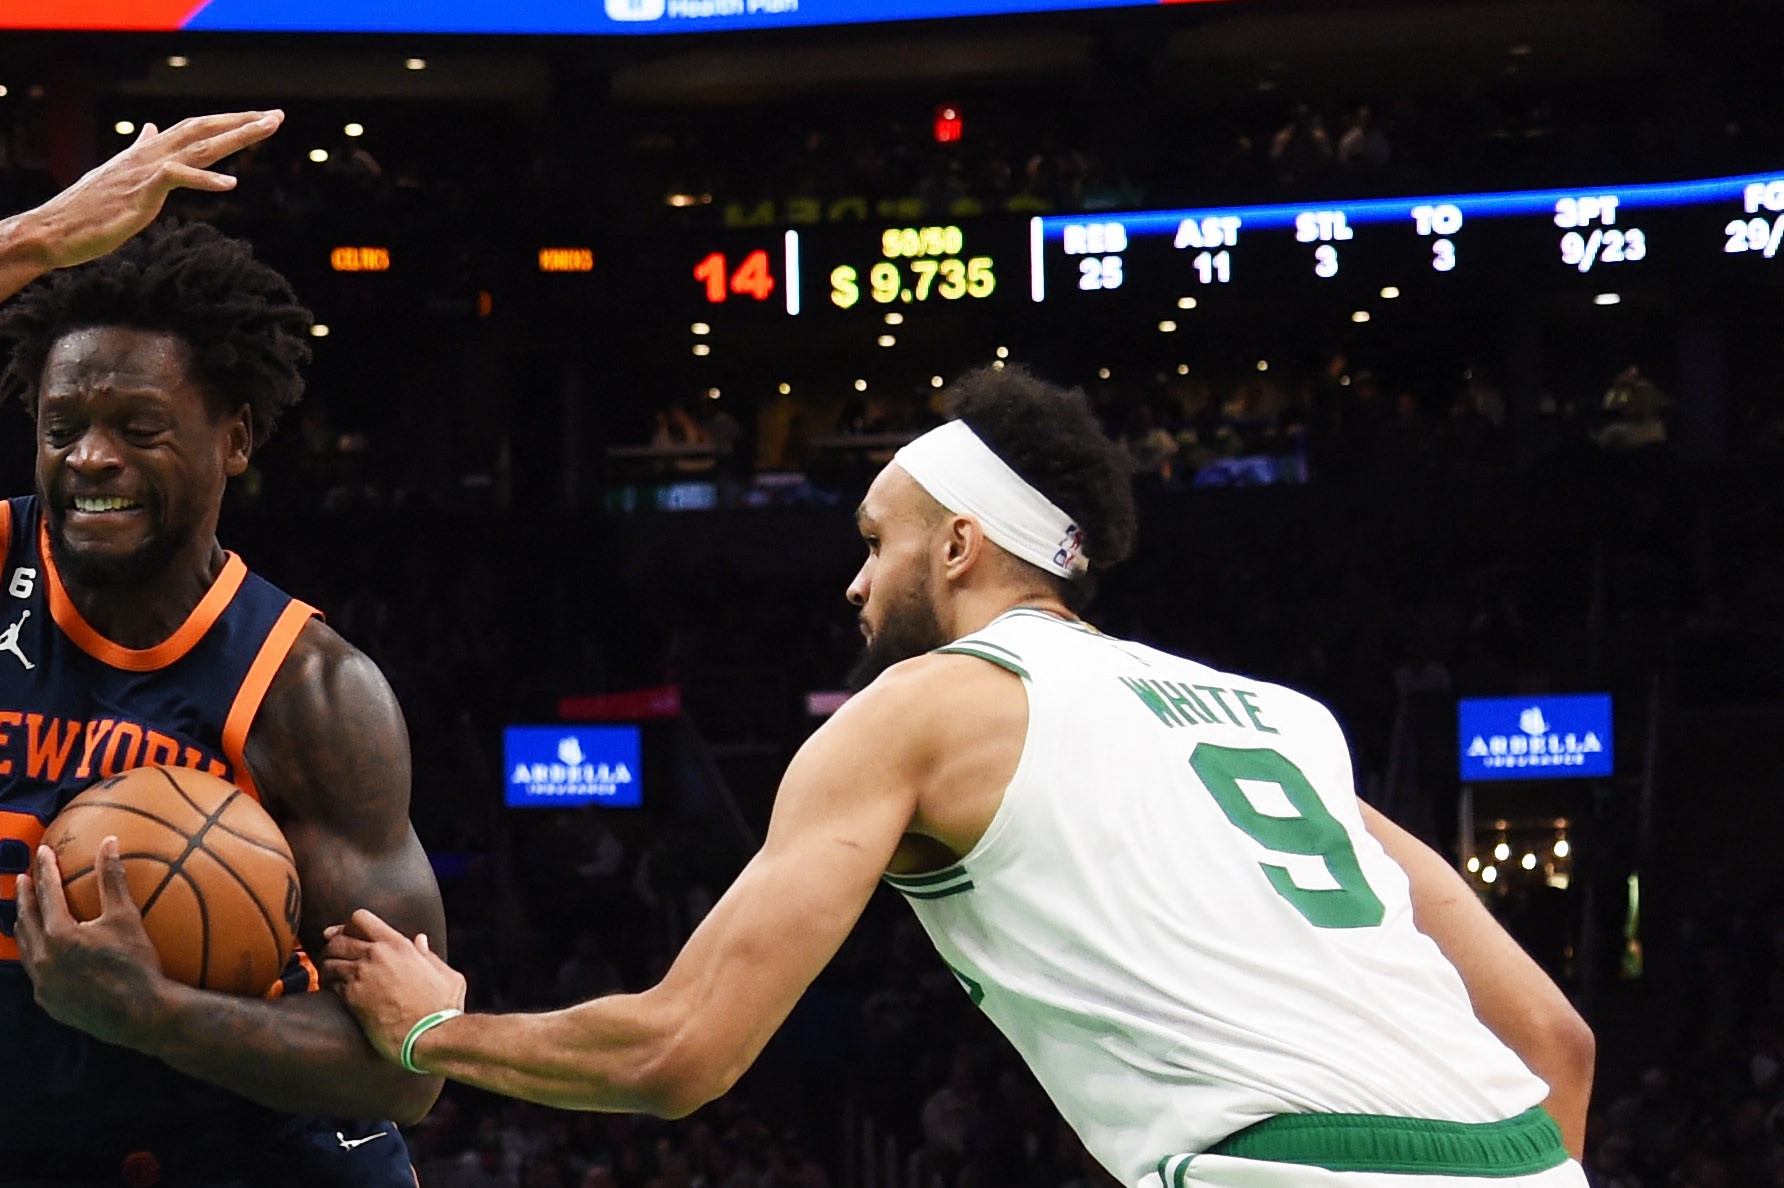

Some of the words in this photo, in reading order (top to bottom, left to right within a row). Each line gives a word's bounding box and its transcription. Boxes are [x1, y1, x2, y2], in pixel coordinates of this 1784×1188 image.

[1174, 215, 1242, 249] AST
[1295, 210, 1354, 243] STL
[1410, 203, 1463, 236] TO
[1553, 195, 1619, 229] 3PT
[693, 249, 775, 303] 14
[1078, 255, 1124, 291] 25
[1191, 250, 1231, 284] 11
[1315, 244, 1339, 278] 3
[1432, 238, 1456, 272] 3
[1559, 227, 1647, 274] 9/23
[8, 566, 37, 600] 6
[1117, 676, 1281, 736] WHITE
[1187, 741, 1386, 929] 9
